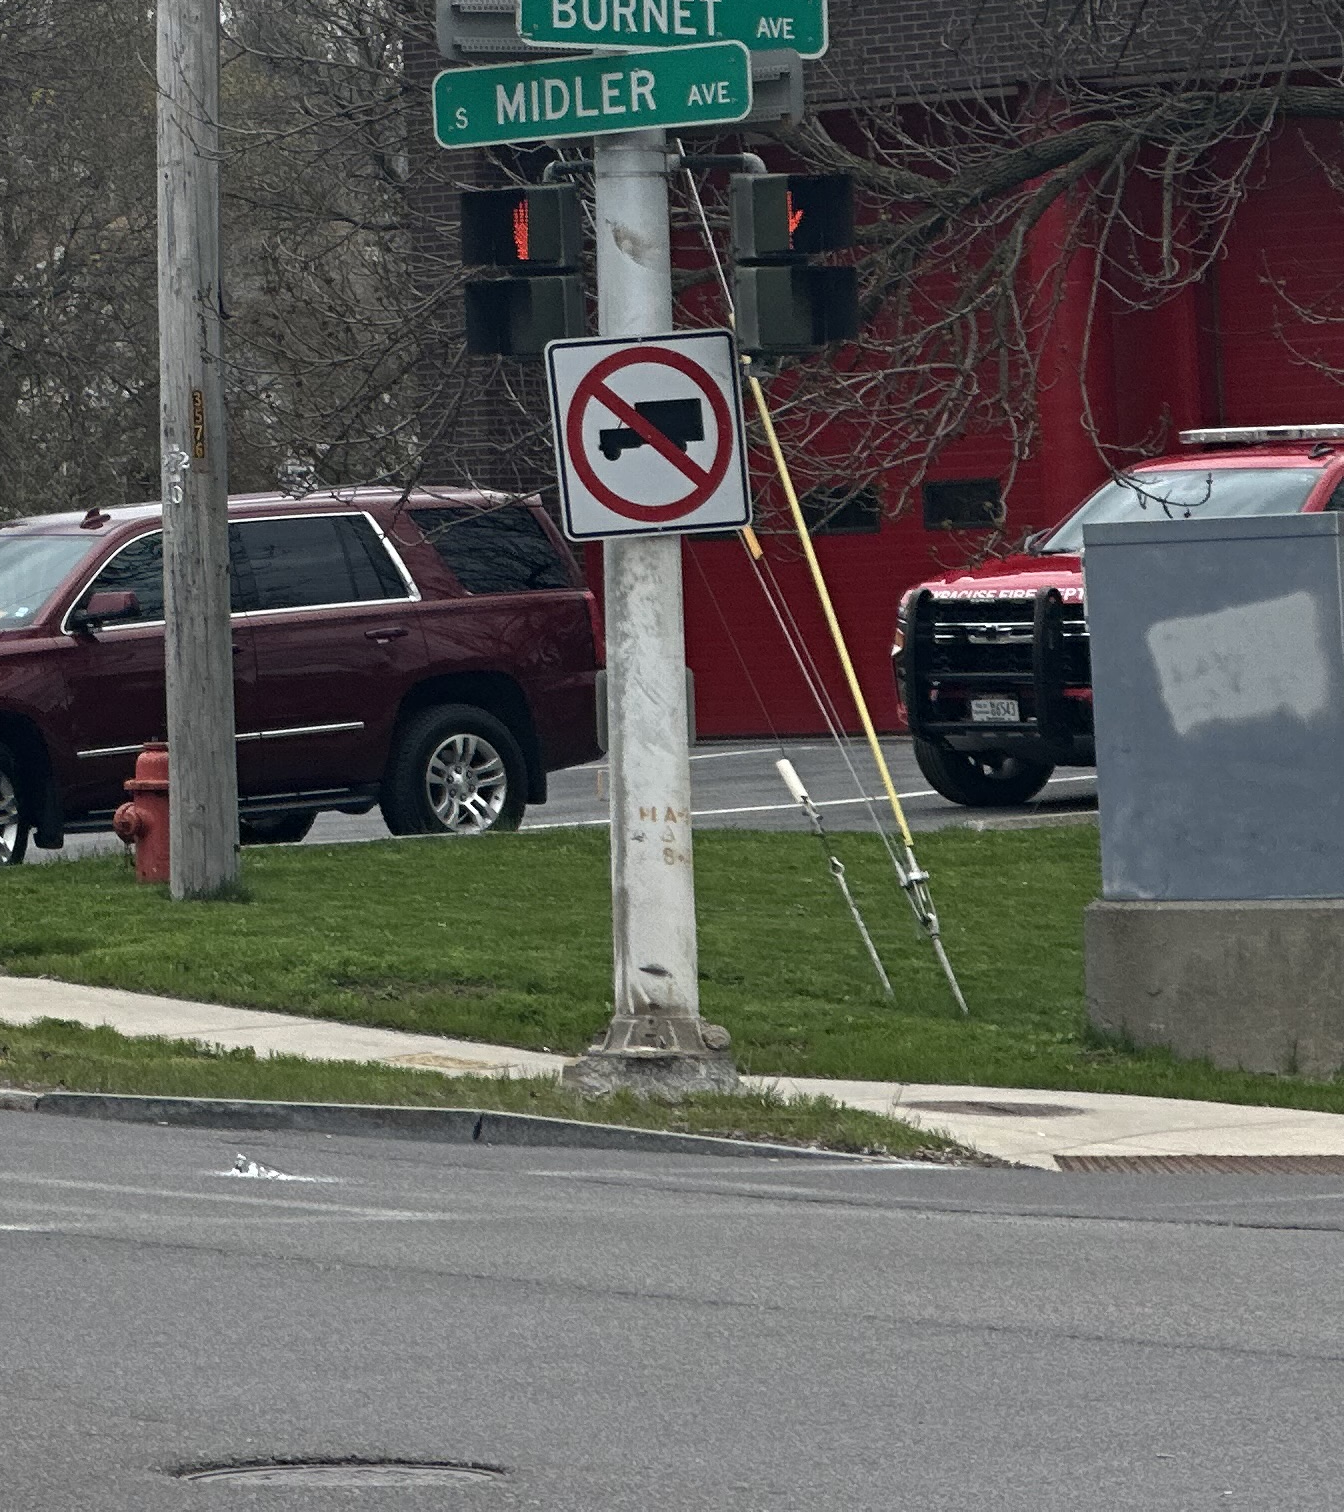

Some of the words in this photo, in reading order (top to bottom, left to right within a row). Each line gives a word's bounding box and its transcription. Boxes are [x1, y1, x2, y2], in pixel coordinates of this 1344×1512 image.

[756, 17, 796, 40] AVE
[454, 107, 469, 130] S
[495, 69, 657, 125] MIDLER
[686, 81, 731, 107] AVE
